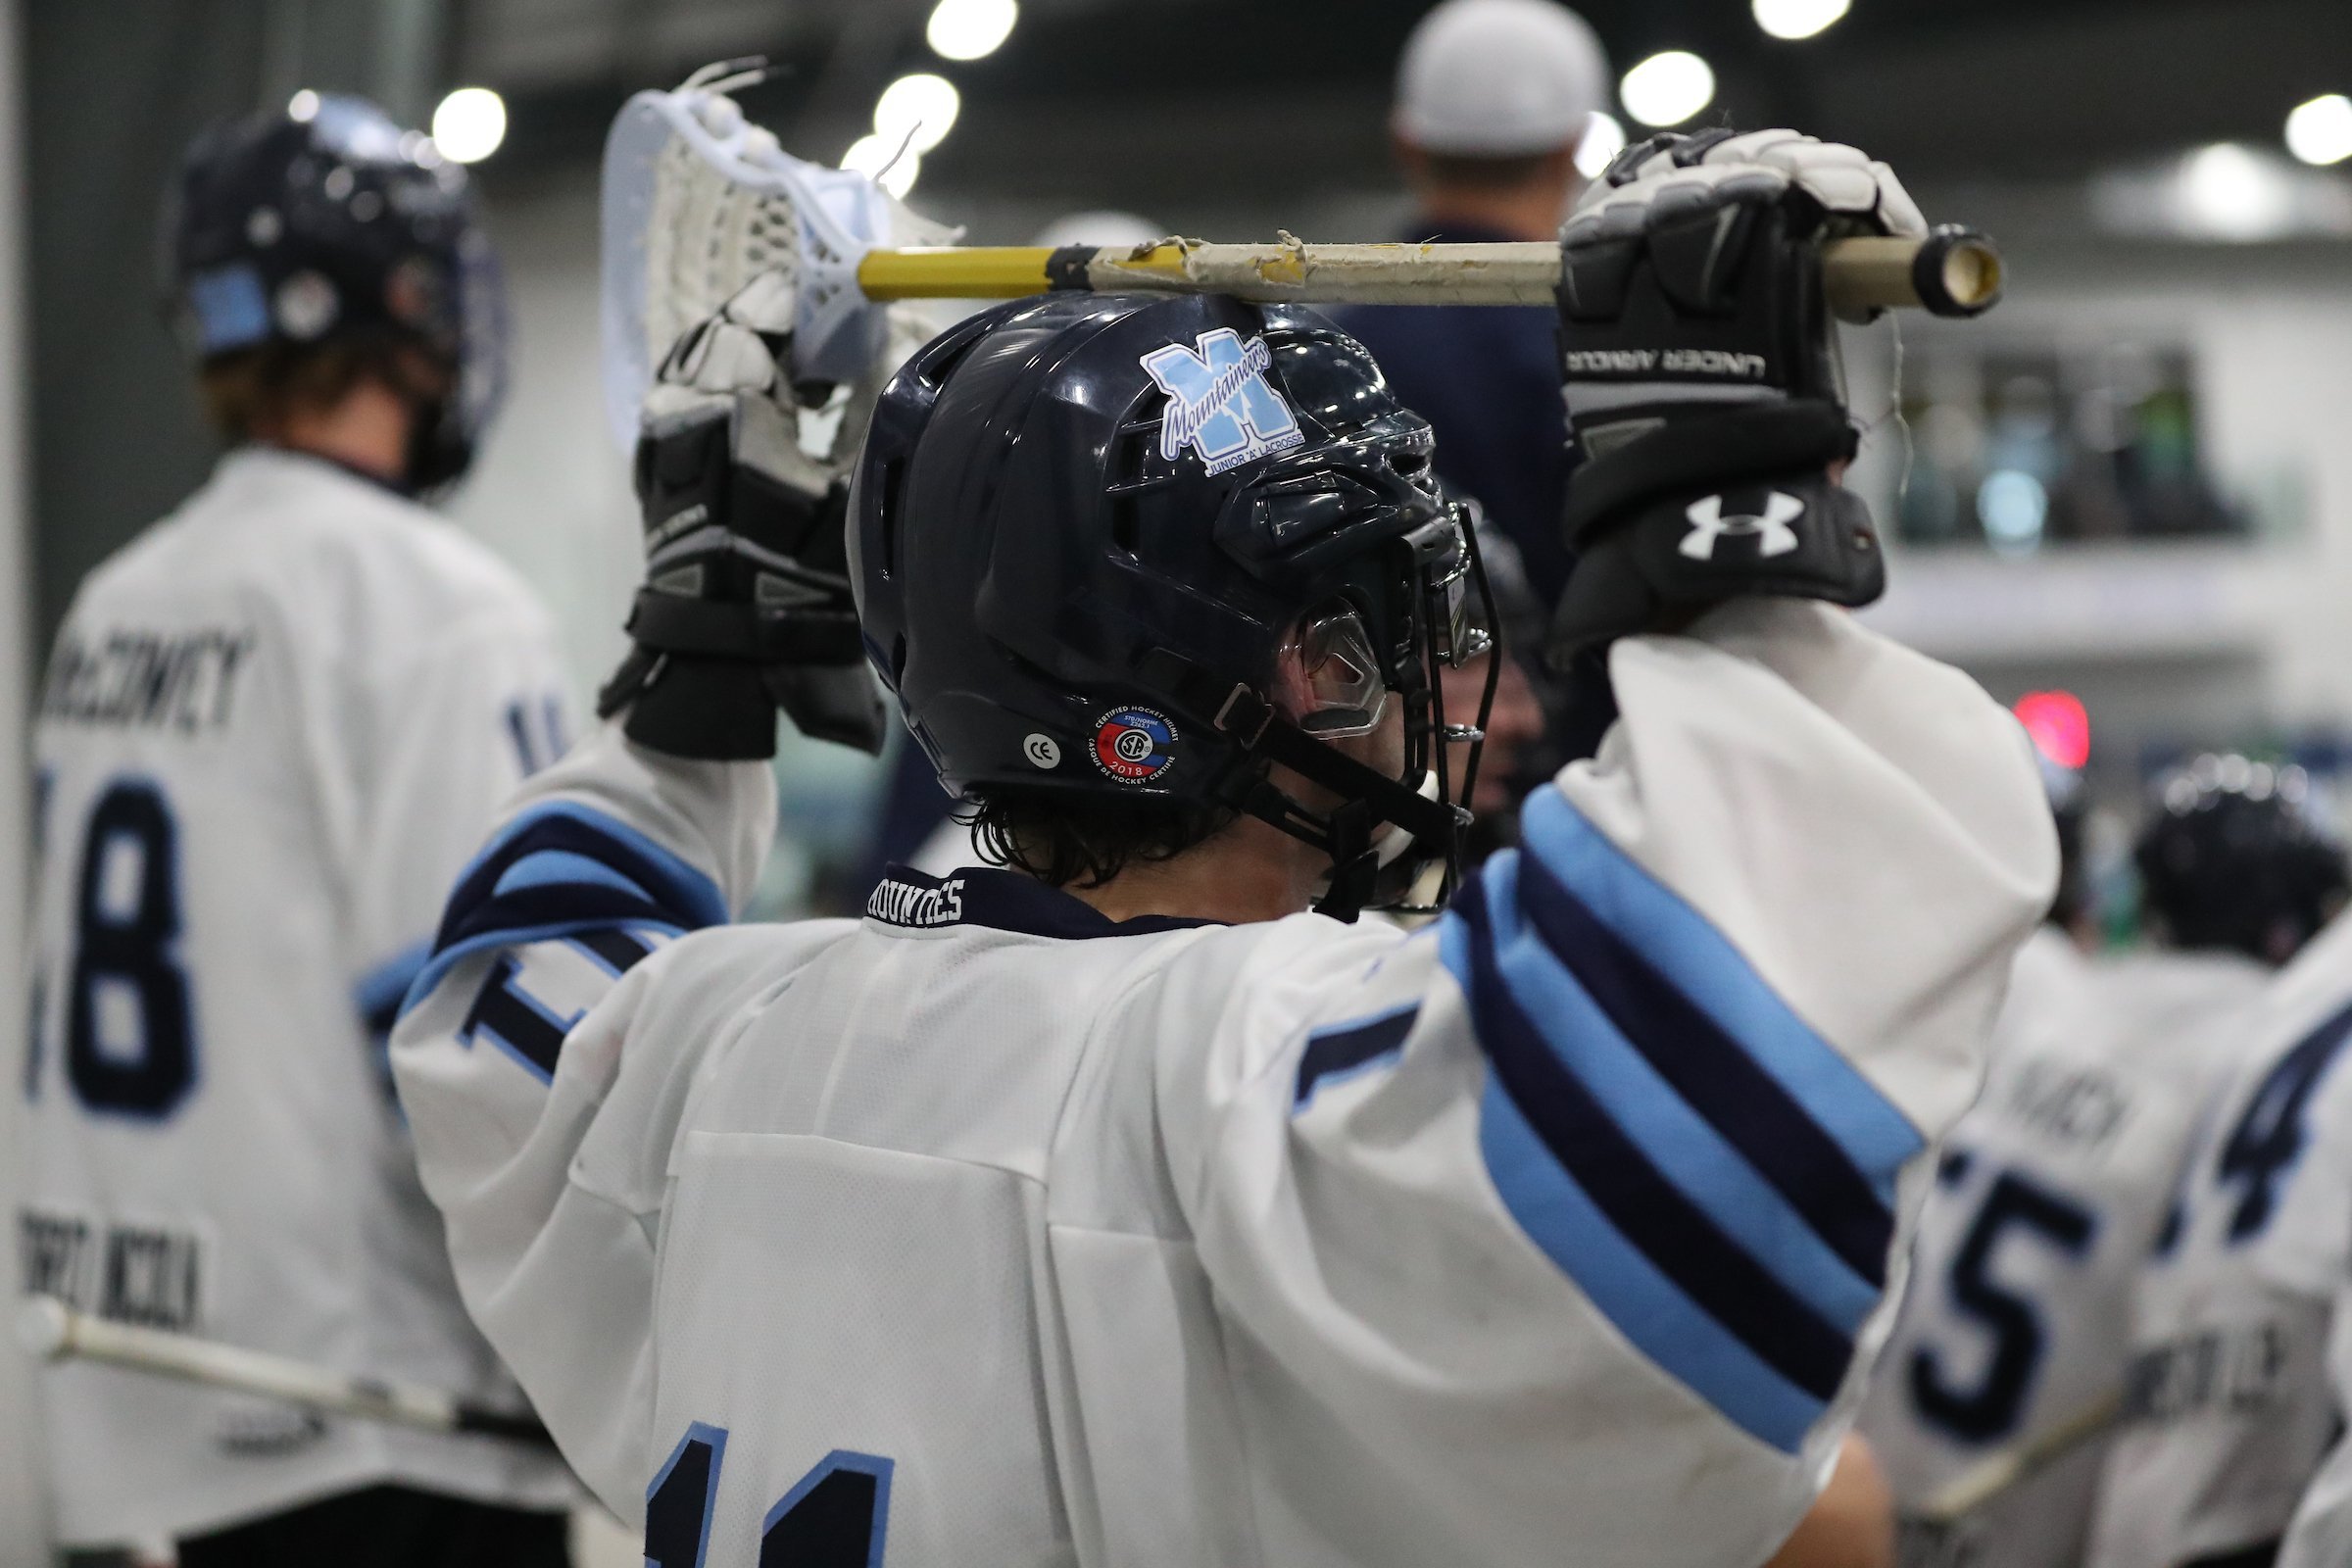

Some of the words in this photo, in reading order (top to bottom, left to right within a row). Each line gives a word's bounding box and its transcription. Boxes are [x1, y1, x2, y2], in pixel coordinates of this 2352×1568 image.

[1663, 349, 1766, 378] UNDER
[1165, 339, 1270, 457] Mountaineers
[1208, 454, 1247, 476] JUNIOR
[1258, 433, 1304, 456] LACROSSE
[1095, 706, 1129, 729] CERTIFIED
[1131, 705, 1165, 719] HOCKEY
[1163, 717, 1179, 742] HELMET
[1030, 741, 1054, 760] CE
[1088, 737, 1102, 767] CASQUE
[1100, 765, 1112, 777] DE
[1110, 773, 1148, 785] HOCKEY
[1108, 760, 1144, 776] 2018
